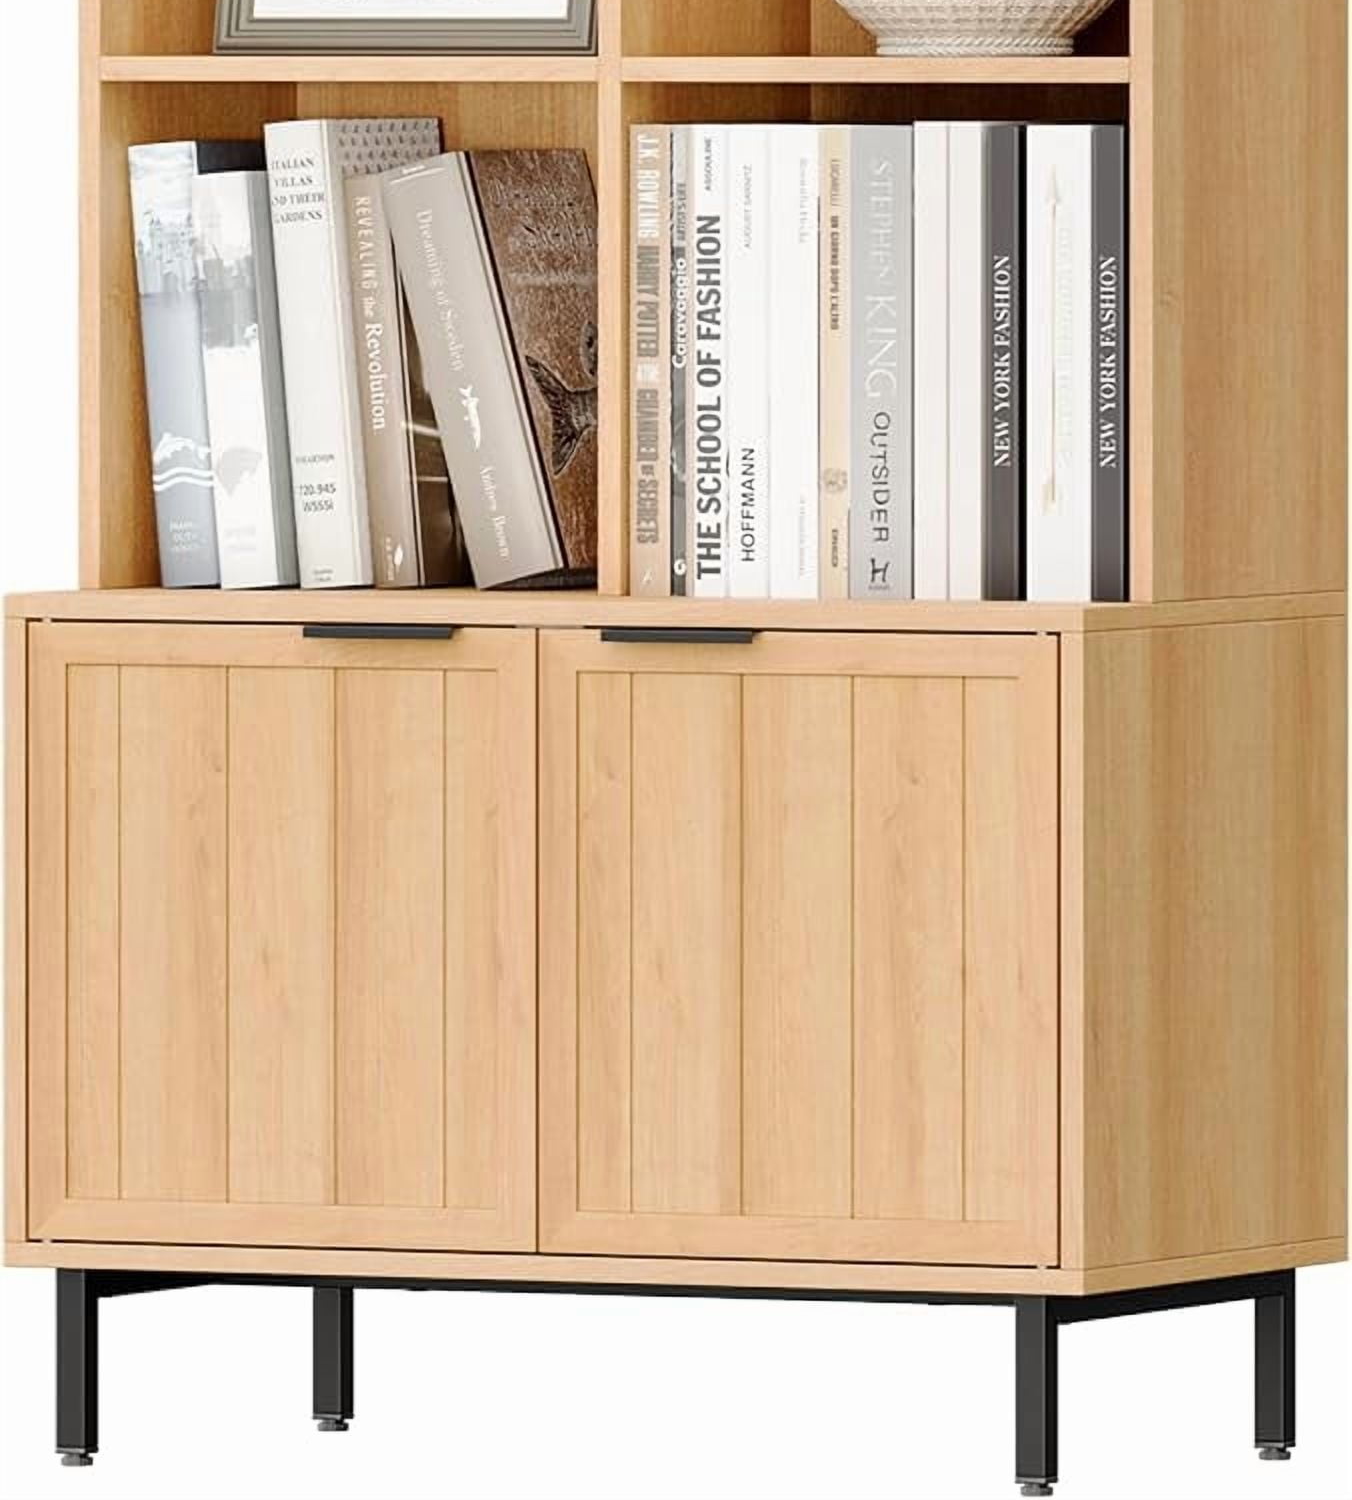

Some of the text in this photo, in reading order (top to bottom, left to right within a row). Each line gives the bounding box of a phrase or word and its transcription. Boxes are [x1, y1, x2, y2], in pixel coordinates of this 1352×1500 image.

[637, 170, 660, 239] ROWLING
[353, 195, 386, 431] REVEALING the Revolution
[637, 301, 660, 357] POTTER
[672, 257, 689, 369] Caravaggio
[864, 159, 896, 542] STEPHEN KING OUTSIDER
[994, 254, 1011, 468] NEW YORK FASHION
[1100, 255, 1117, 468] NEW YORK FASHION
[696, 215, 722, 580] THE SCHOOL OF FASHION
[637, 479, 659, 543] SECRETS
[741, 448, 756, 562] HOFFMANN
